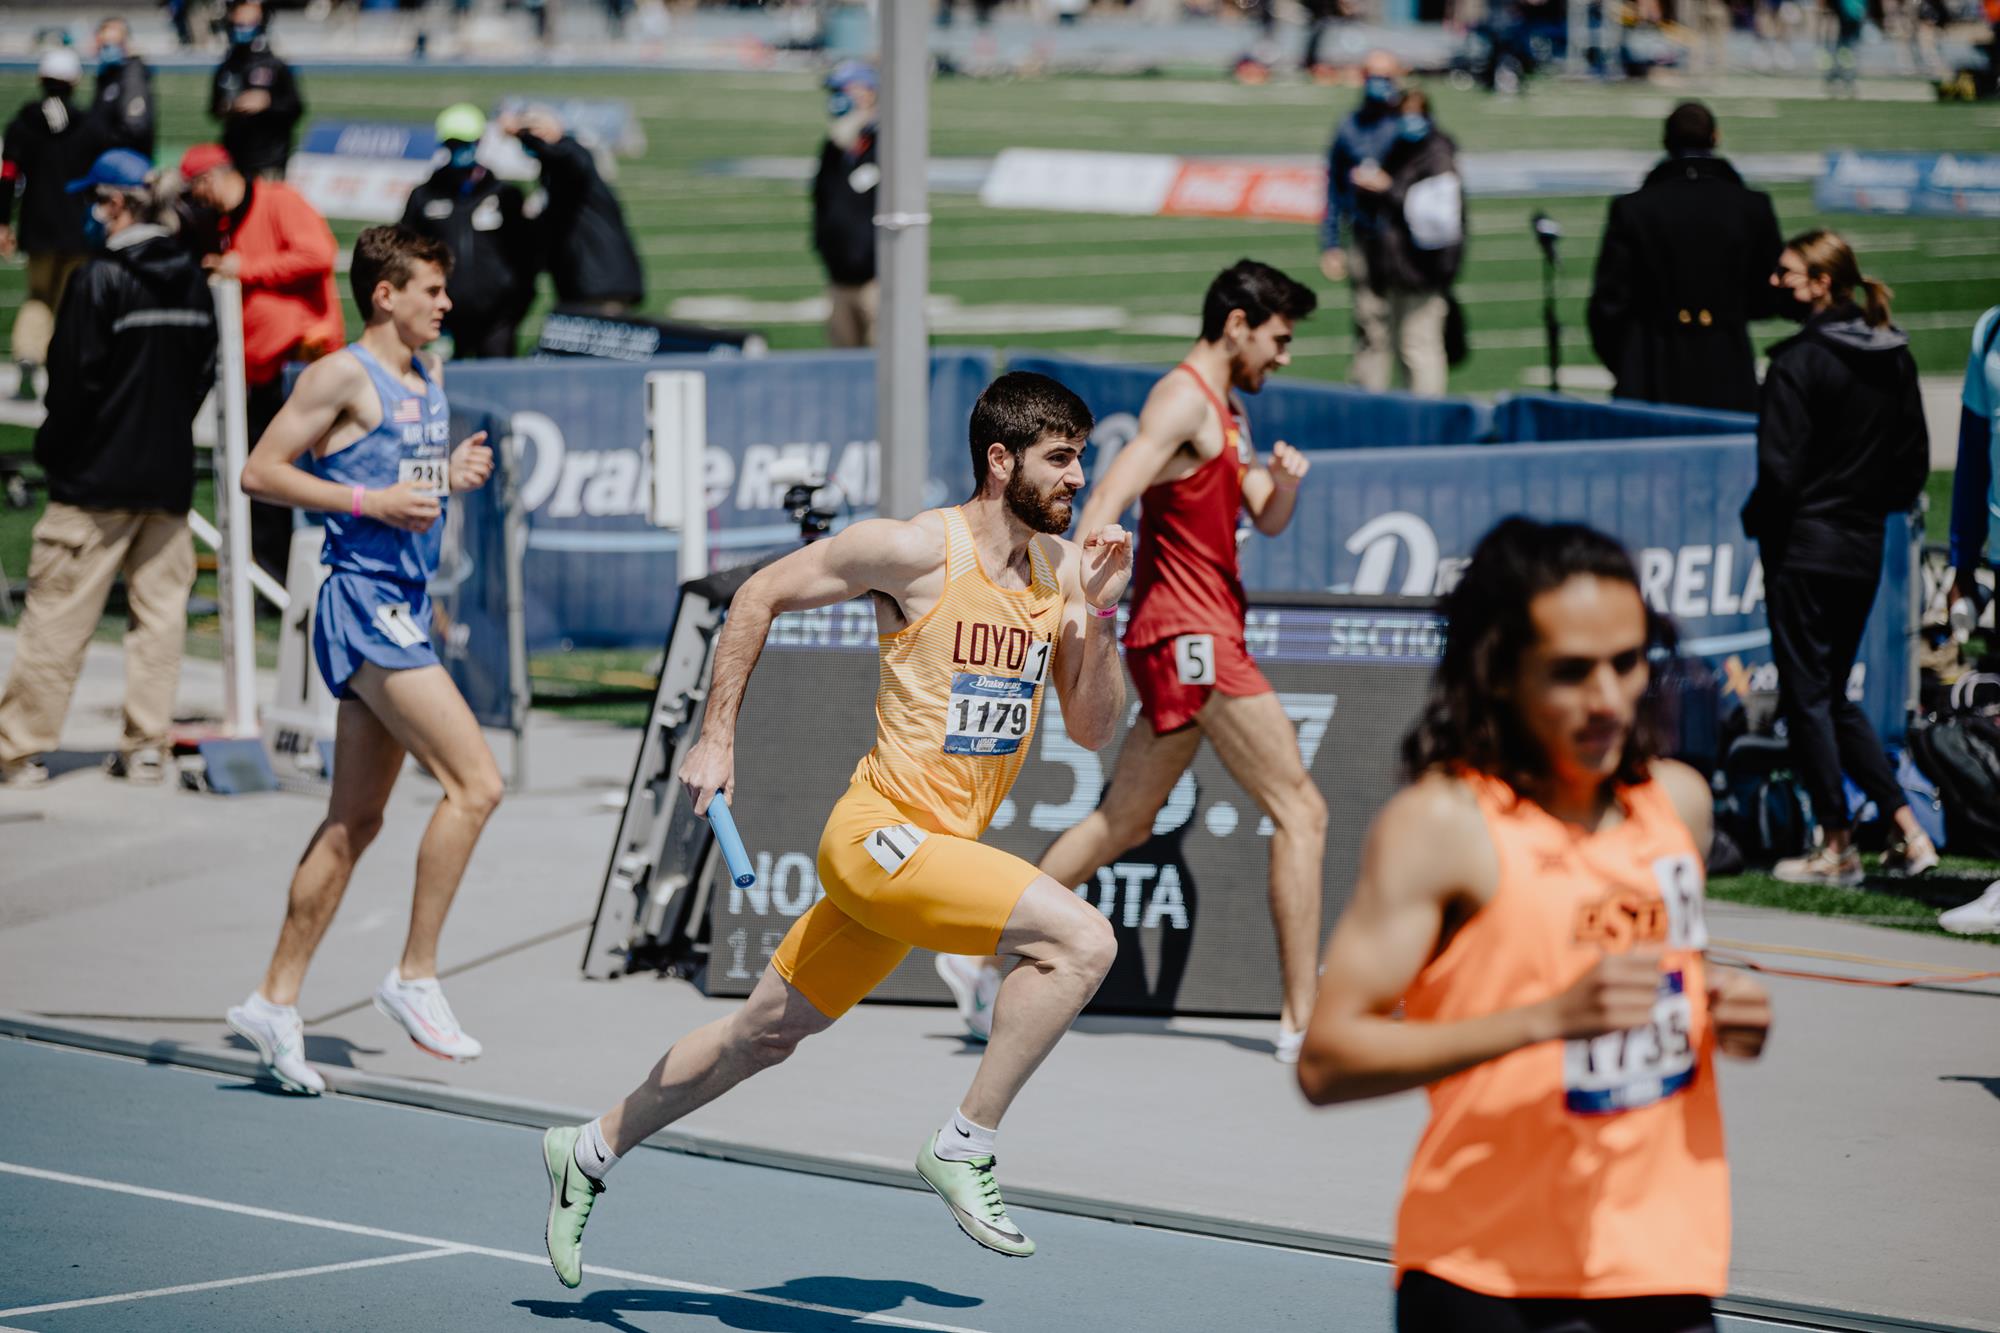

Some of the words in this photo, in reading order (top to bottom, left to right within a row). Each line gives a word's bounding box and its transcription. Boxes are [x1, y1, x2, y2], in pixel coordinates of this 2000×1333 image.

[952, 621, 1052, 672] LOYO
[1036, 645, 1048, 682] 1
[1189, 642, 1204, 679] 5
[955, 699, 1028, 736] 1179
